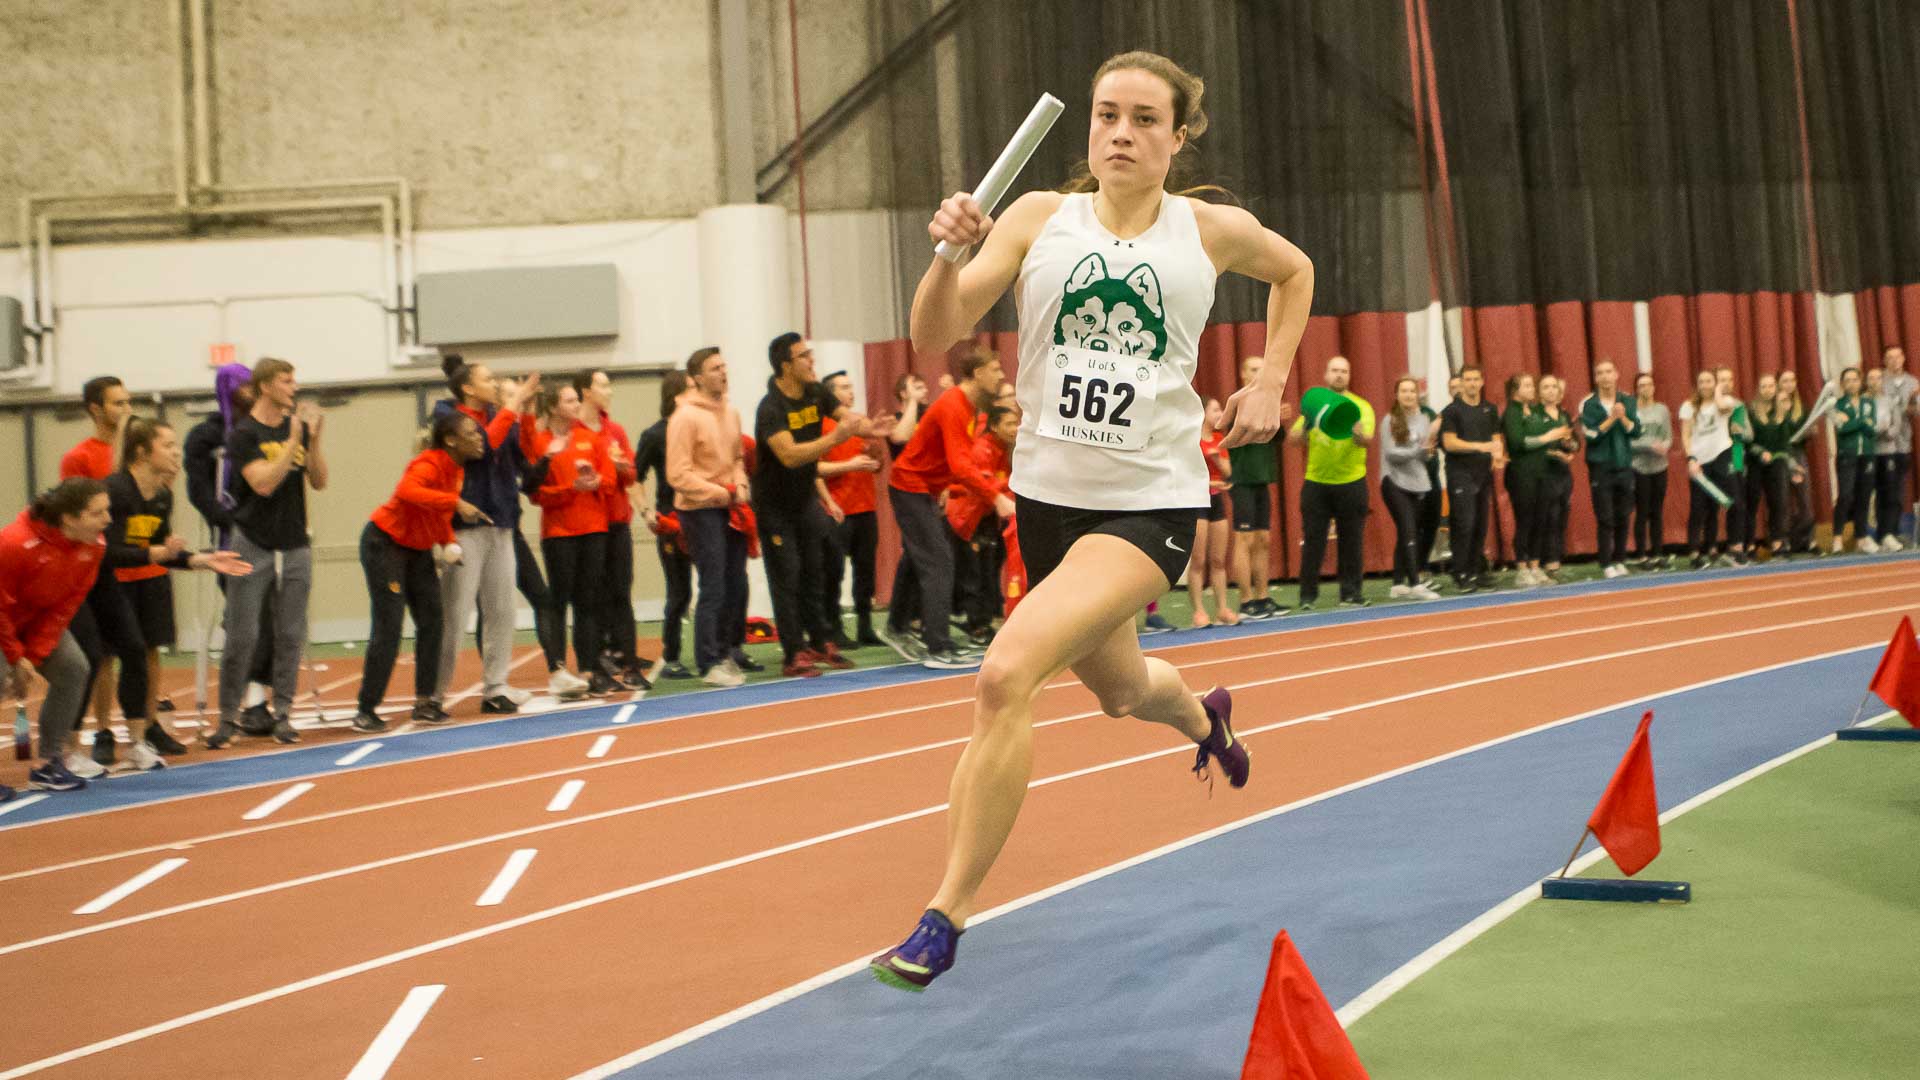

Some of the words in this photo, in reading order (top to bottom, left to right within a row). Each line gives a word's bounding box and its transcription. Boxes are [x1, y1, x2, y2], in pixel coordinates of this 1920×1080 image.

[1088, 359, 1096, 369] U
[1098, 361, 1109, 371] of
[1110, 362, 1116, 372] S
[1058, 374, 1136, 427] 562
[1061, 425, 1124, 445] HUSKIES
